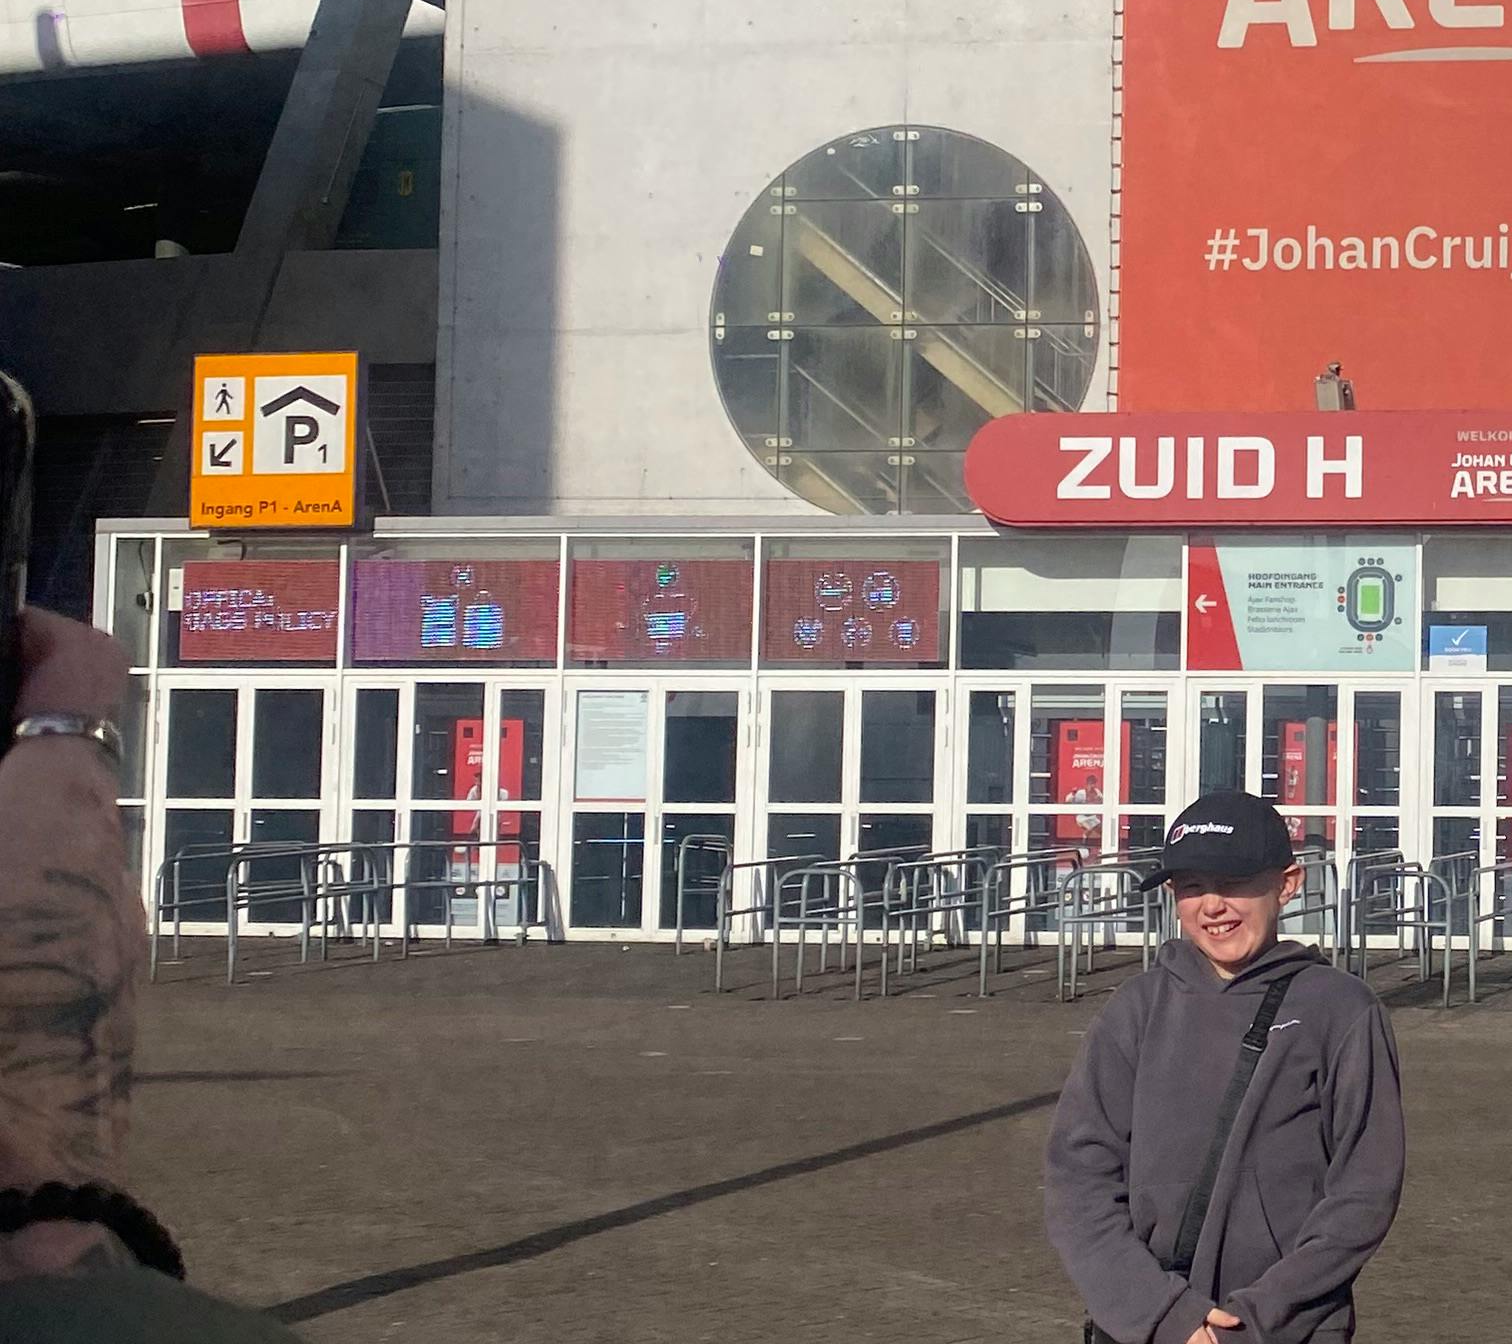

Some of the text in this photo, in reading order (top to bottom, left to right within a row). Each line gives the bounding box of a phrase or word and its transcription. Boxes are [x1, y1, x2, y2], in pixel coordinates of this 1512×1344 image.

[1057, 435, 1363, 500] ZUID H
[1451, 453, 1506, 467] JOHAN
[201, 503, 253, 518] Ingang
[259, 501, 277, 513] P1
[293, 500, 342, 513] ArenA
[1183, 821, 1234, 834] berghaus
